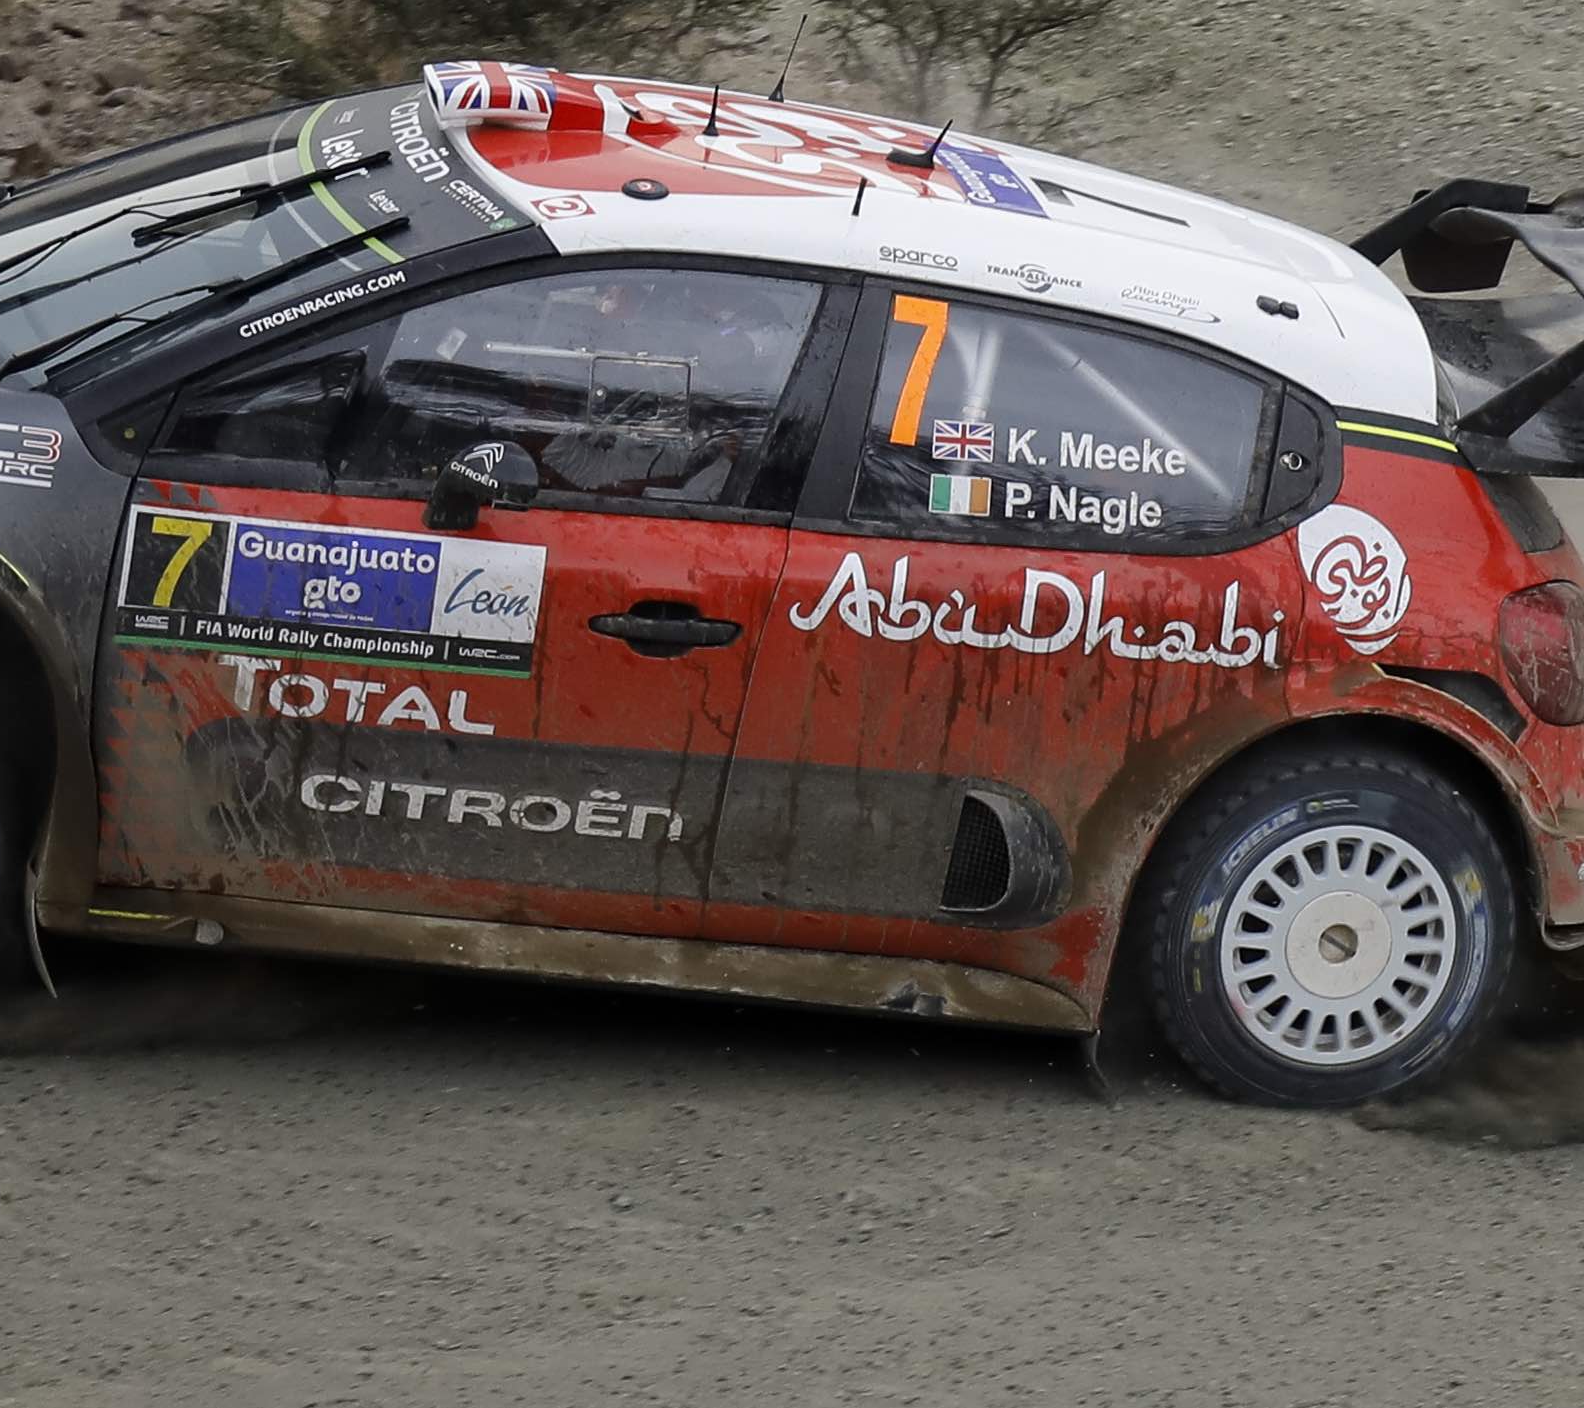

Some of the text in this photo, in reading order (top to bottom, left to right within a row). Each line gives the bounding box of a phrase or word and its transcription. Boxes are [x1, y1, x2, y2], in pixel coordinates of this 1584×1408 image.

[448, 179, 505, 221] CERTINA
[879, 245, 959, 268] sparco
[986, 264, 1084, 289] TRANSALLIANCE
[239, 270, 407, 339] CITROENRACING.COM
[889, 294, 950, 447] 7
[1007, 426, 1187, 477] K. Meeke
[1004, 482, 1164, 535] P. Nagle
[151, 515, 213, 608] 7
[238, 530, 436, 575] Guanajuato
[302, 576, 362, 610] gto
[443, 567, 530, 617] León
[196, 619, 435, 659] FIA World Rally Championship
[216, 653, 497, 736] TOTAL
